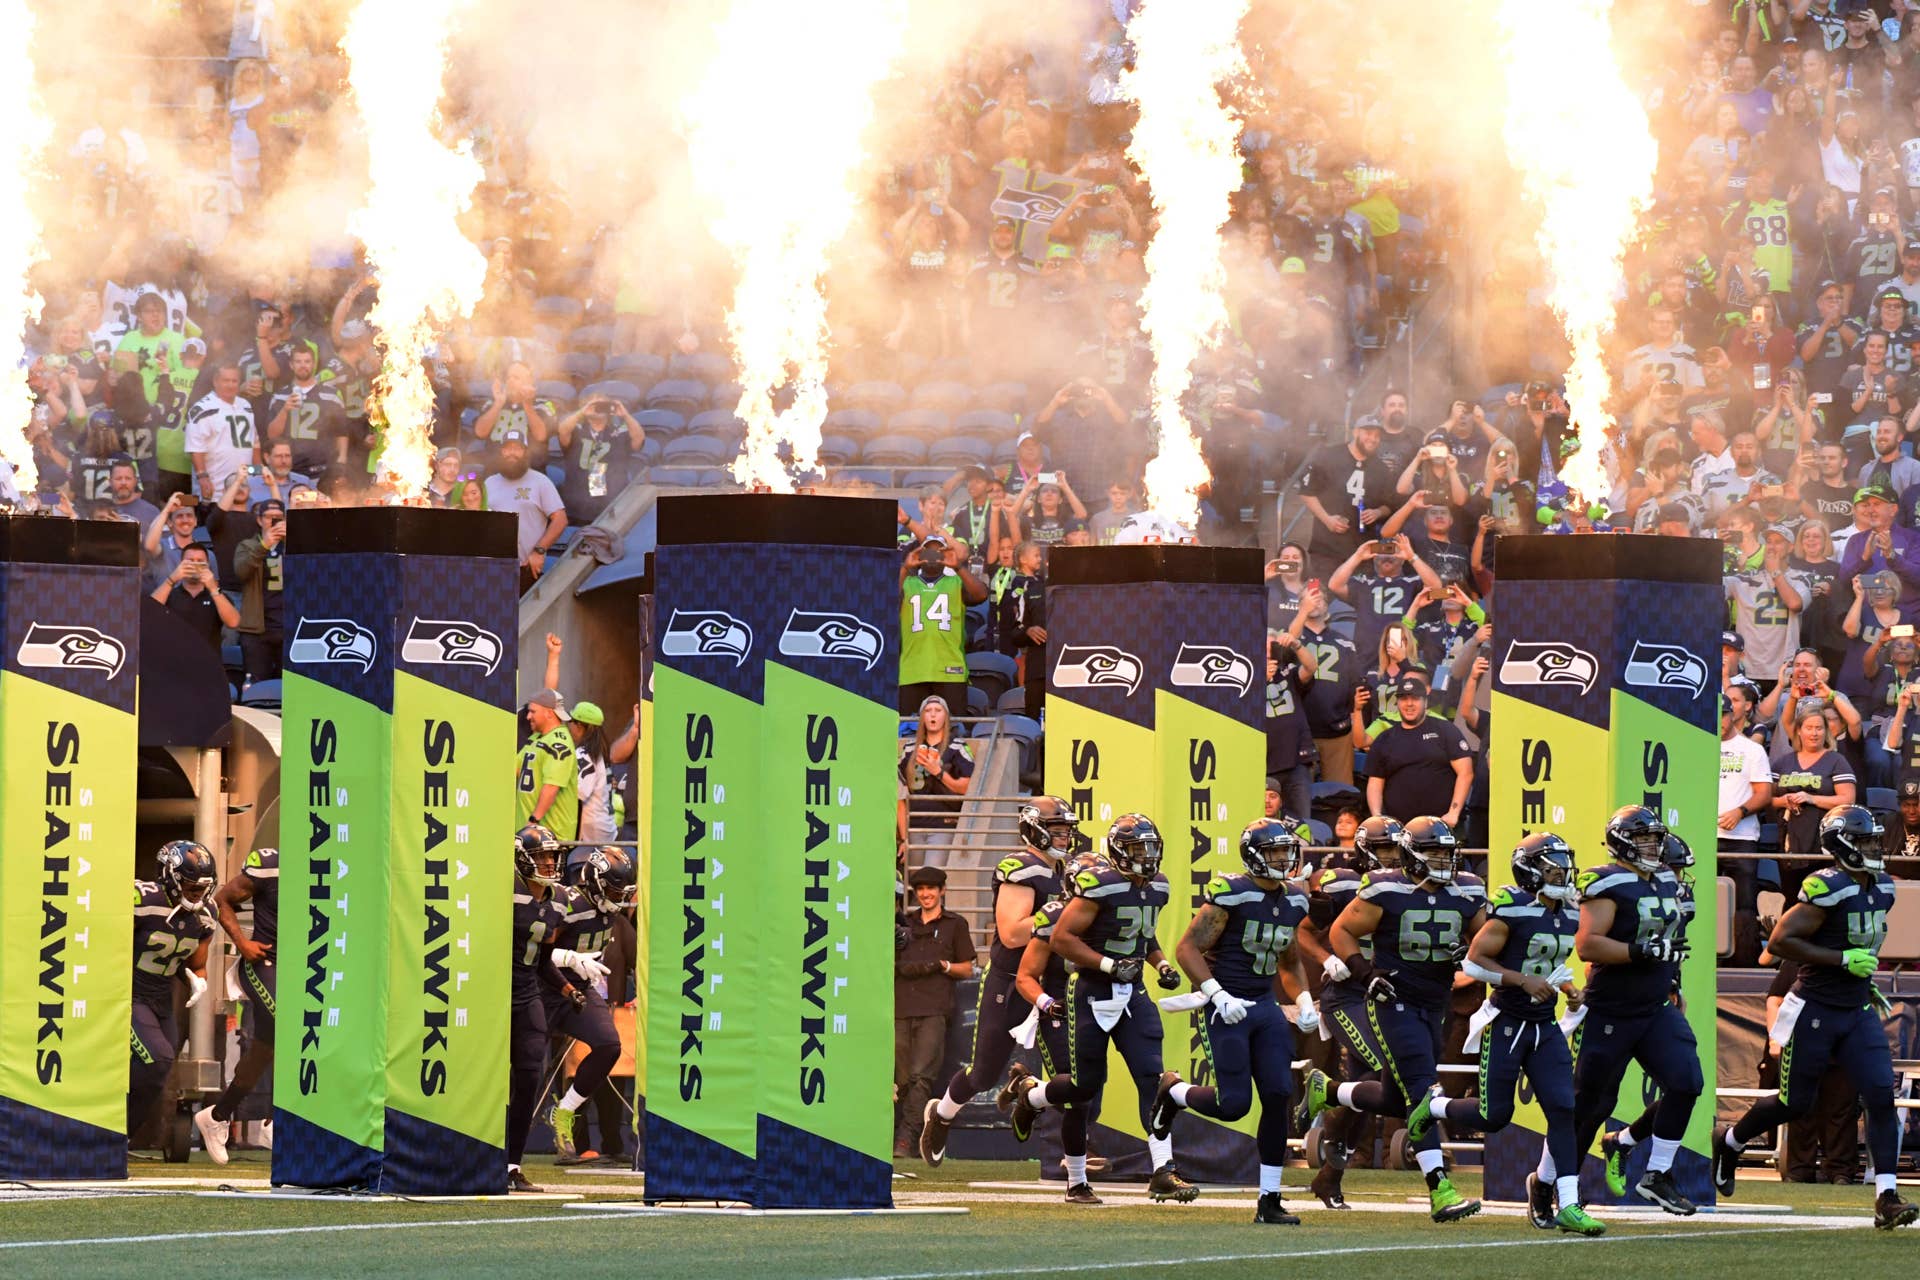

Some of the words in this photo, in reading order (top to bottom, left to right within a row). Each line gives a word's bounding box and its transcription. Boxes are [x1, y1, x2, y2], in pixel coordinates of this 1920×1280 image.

[1313, 233, 1334, 263] 3
[1745, 216, 1789, 246] 88
[988, 271, 1017, 308] 12
[1824, 331, 1843, 358] 3
[123, 426, 154, 460] 12
[225, 415, 253, 449] 12
[289, 403, 320, 440] 12
[83, 468, 114, 501] 12
[1347, 470, 1366, 507] 4
[1817, 498, 1852, 515] VANS
[909, 593, 952, 632] 14
[1371, 586, 1405, 615] 12
[1307, 642, 1339, 682] 12
[36, 721, 80, 1086] SEAHAWKS
[71, 787, 93, 1019] SEATTLE
[299, 718, 338, 1096] SEAHAWKS
[327, 787, 349, 1027] SEATTLE
[420, 719, 455, 1097] SEAHAWKS
[455, 787, 469, 1027] SEATTLE
[679, 713, 714, 1103] SEAHAWKS
[708, 784, 726, 1031] SEATTLE
[800, 714, 838, 1106] SEAHAWKS
[833, 786, 851, 1034] SEATTLE
[523, 920, 547, 966] 1
[1104, 905, 1160, 955] 34
[1242, 919, 1294, 976] 48
[1399, 909, 1463, 962] 63
[136, 930, 200, 977] 22
